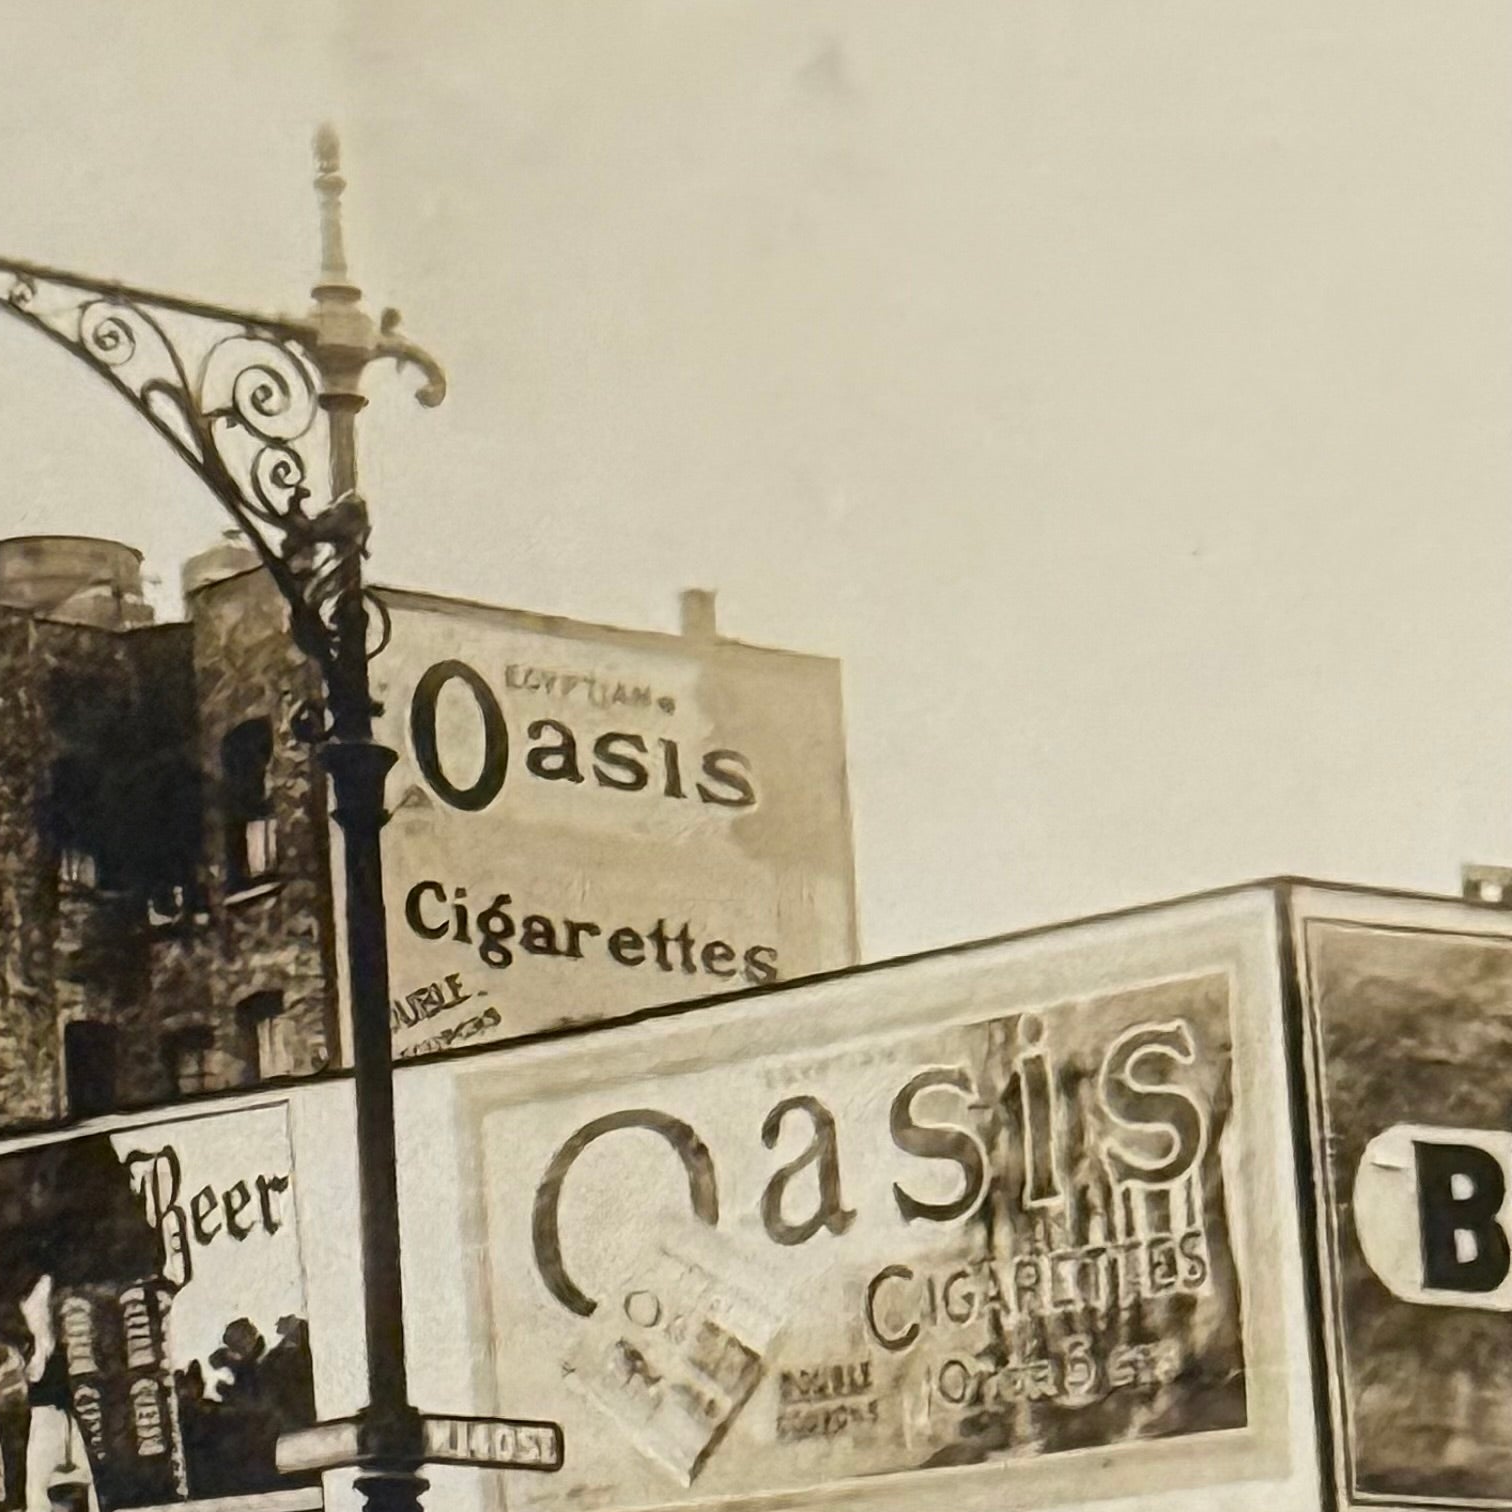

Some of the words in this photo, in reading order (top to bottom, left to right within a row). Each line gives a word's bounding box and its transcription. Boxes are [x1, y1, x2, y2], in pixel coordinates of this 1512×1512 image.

[410, 658, 757, 812] Oasis
[405, 881, 779, 984] Cigarettes
[126, 1145, 290, 1284] Beer
